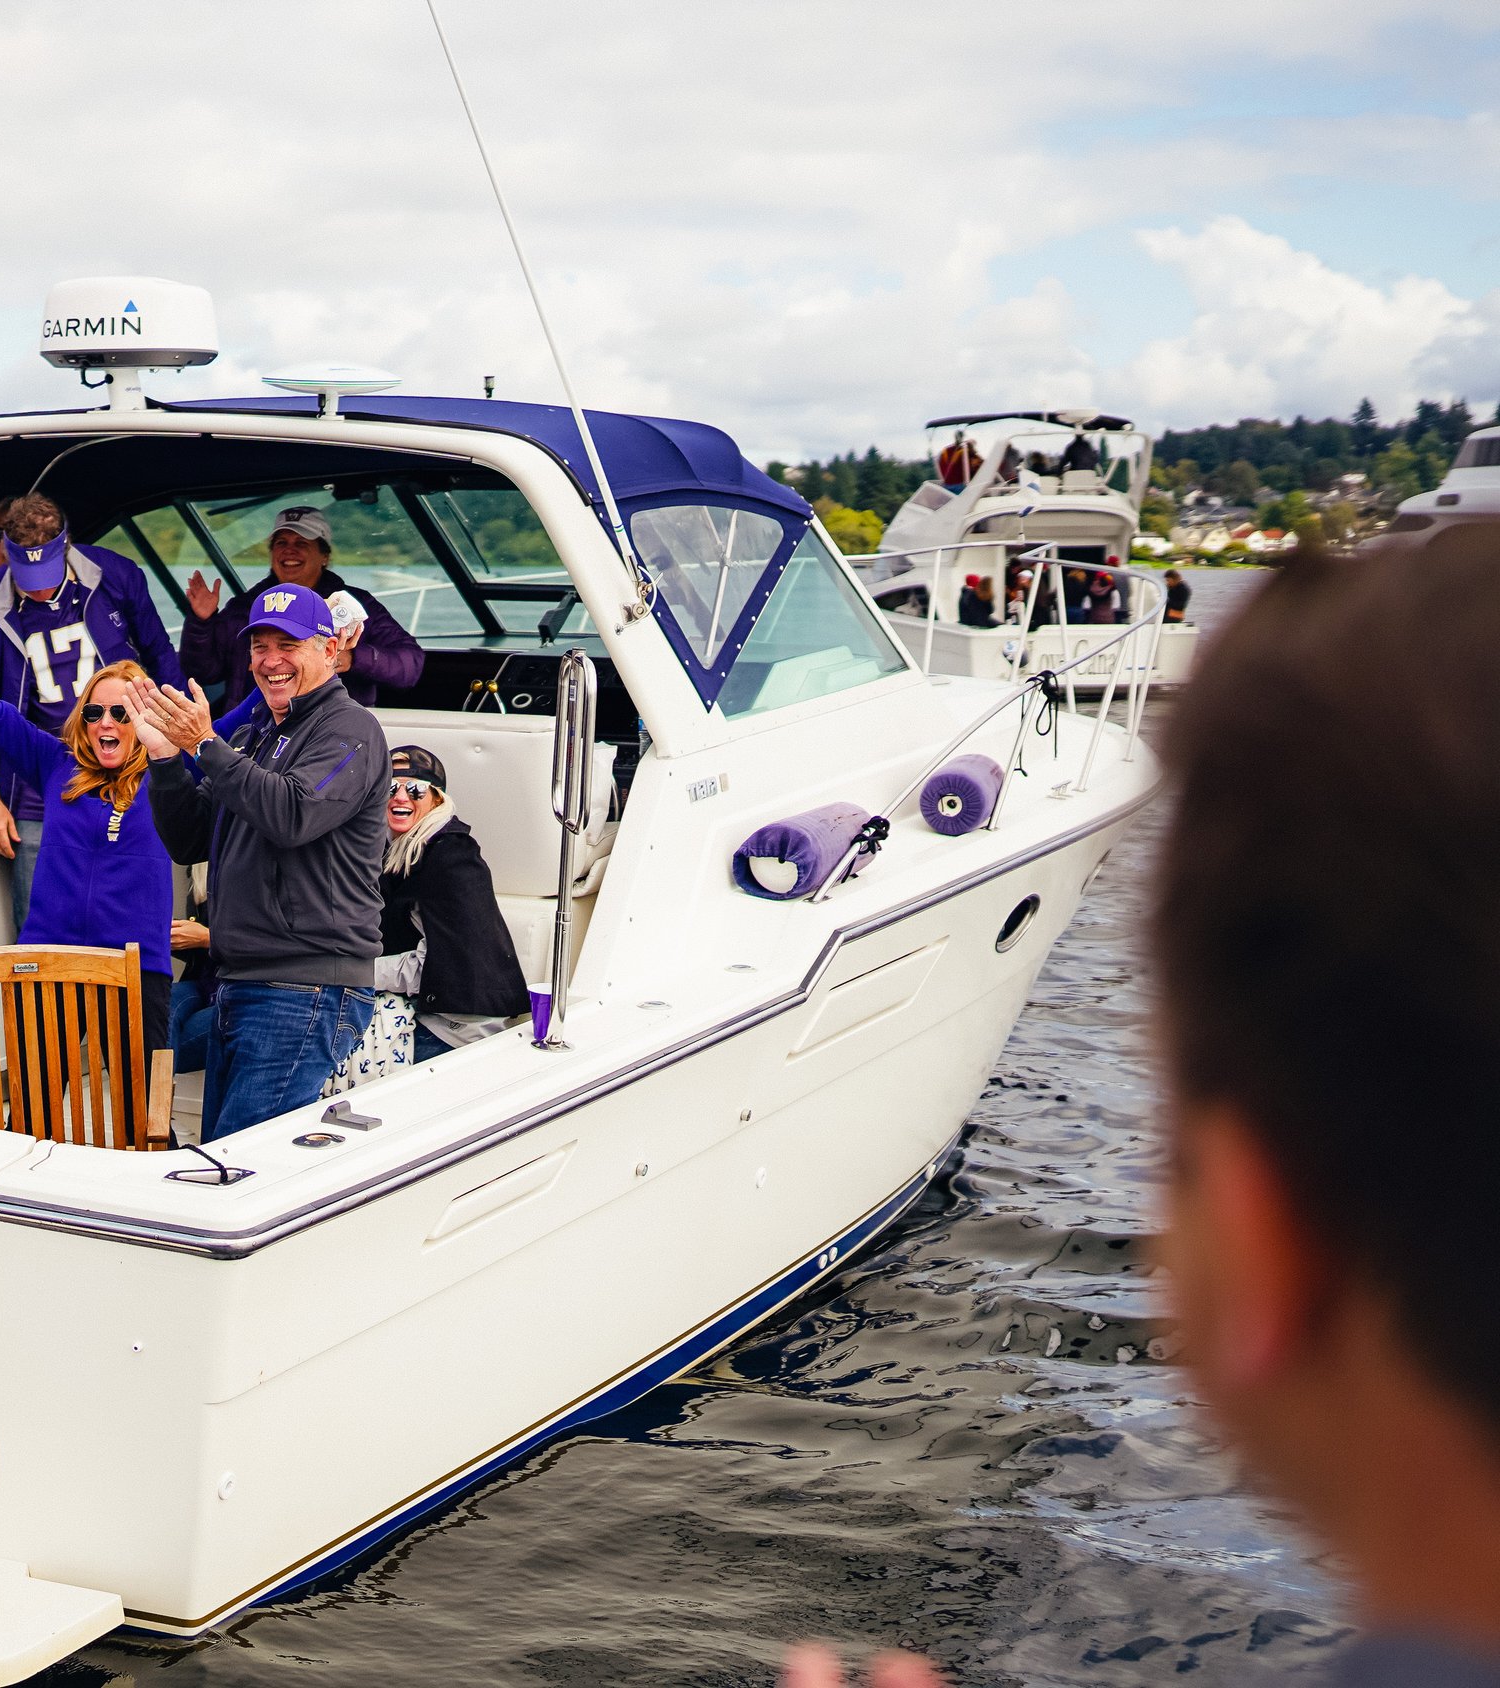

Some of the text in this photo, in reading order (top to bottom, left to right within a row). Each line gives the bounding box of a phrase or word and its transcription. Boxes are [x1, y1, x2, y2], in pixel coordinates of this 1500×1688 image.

[43, 316, 142, 338] GARMIN
[25, 549, 43, 562] W
[263, 591, 297, 613] W
[24, 621, 97, 704] 17
